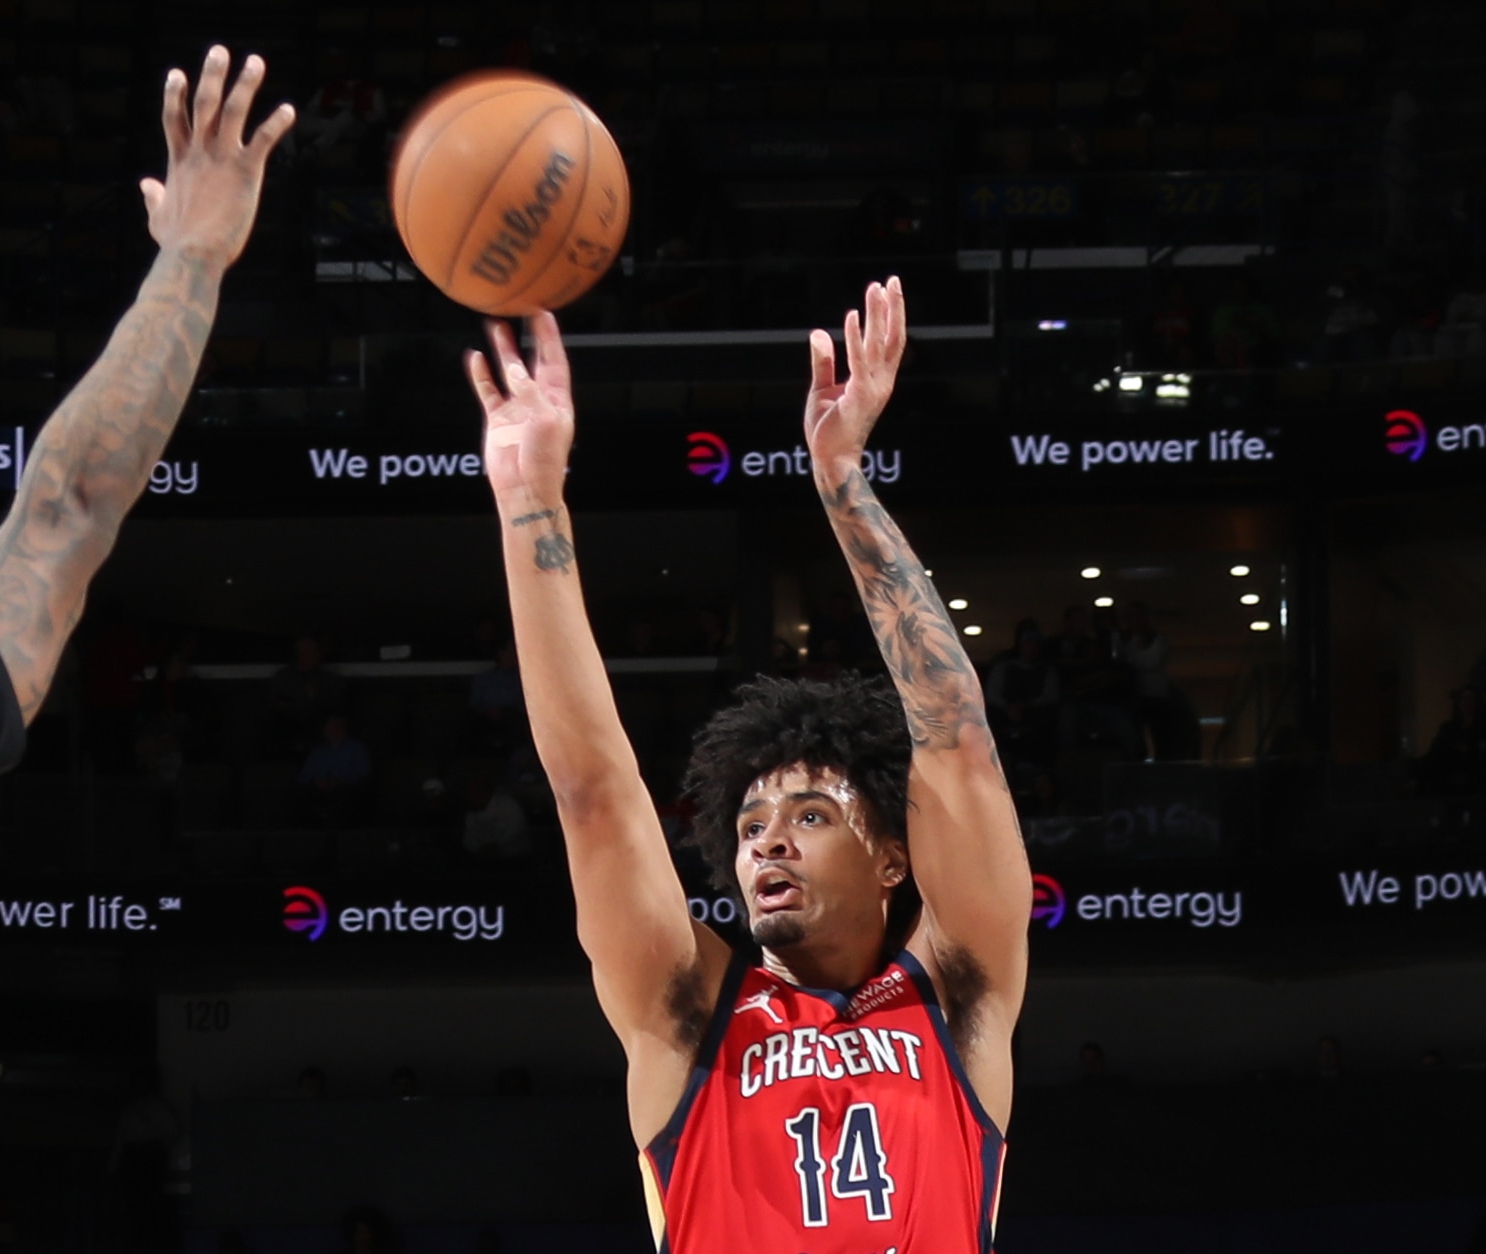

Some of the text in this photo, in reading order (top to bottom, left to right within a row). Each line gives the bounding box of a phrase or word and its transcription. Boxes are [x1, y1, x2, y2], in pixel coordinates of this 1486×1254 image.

[470, 149, 577, 287] Wilson
[1003, 184, 1074, 217] 326
[308, 447, 487, 487] We powe
[740, 446, 903, 485] entgy
[1009, 433, 1071, 466] We
[1081, 438, 1200, 473] power
[1075, 886, 1244, 929] entergy
[1338, 869, 1402, 908] We
[336, 899, 505, 942] entergy
[183, 1000, 232, 1033] 120
[739, 1026, 923, 1099] CRECENT
[784, 1101, 896, 1228] 14
